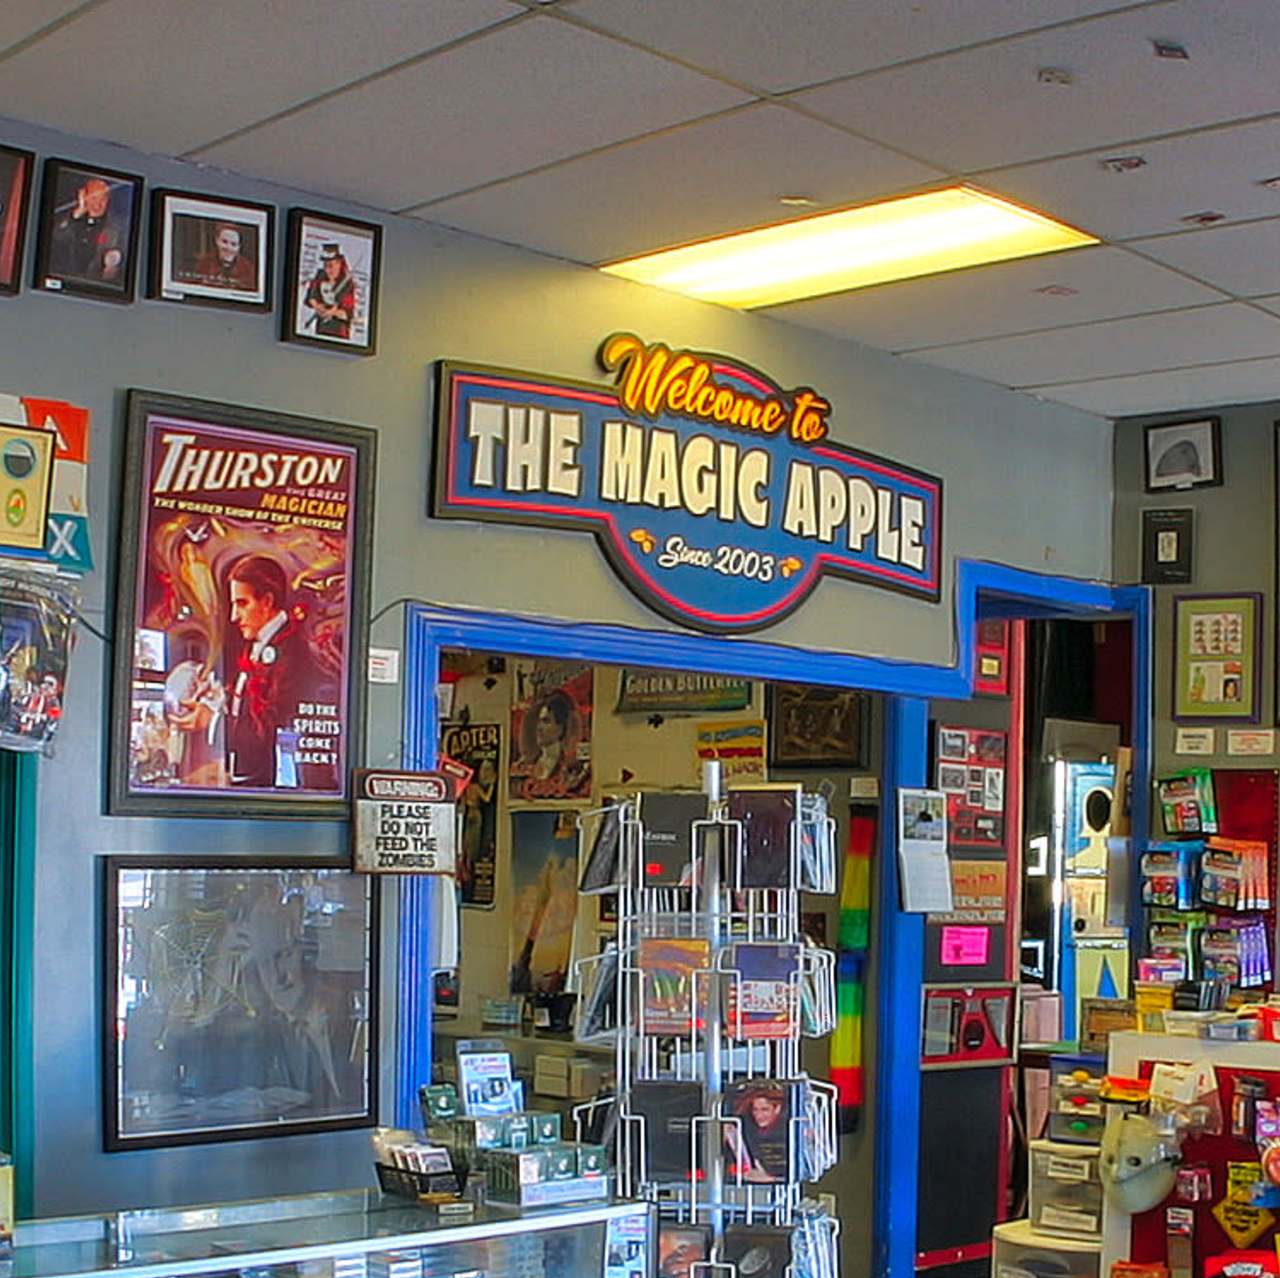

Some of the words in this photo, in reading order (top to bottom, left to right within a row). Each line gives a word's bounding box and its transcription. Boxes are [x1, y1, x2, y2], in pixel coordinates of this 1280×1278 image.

[601, 333, 785, 435] Welcome
[787, 388, 829, 444] to
[153, 434, 343, 493] THURSTON
[467, 400, 583, 497] THE
[601, 420, 771, 527] MAGIC
[783, 461, 926, 571] APPLE
[261, 493, 346, 517] MAGICIAN
[658, 536, 713, 568] Since
[713, 546, 774, 581] 2003
[293, 719, 340, 734] SPIRITS
[299, 737, 332, 750] COME
[381, 804, 431, 819] PLEASE
[381, 821, 400, 835] DO
[405, 822, 431, 836] NOT
[375, 837, 408, 850] FEED
[413, 838, 437, 851] THE
[378, 853, 435, 868] ZOMBIES
